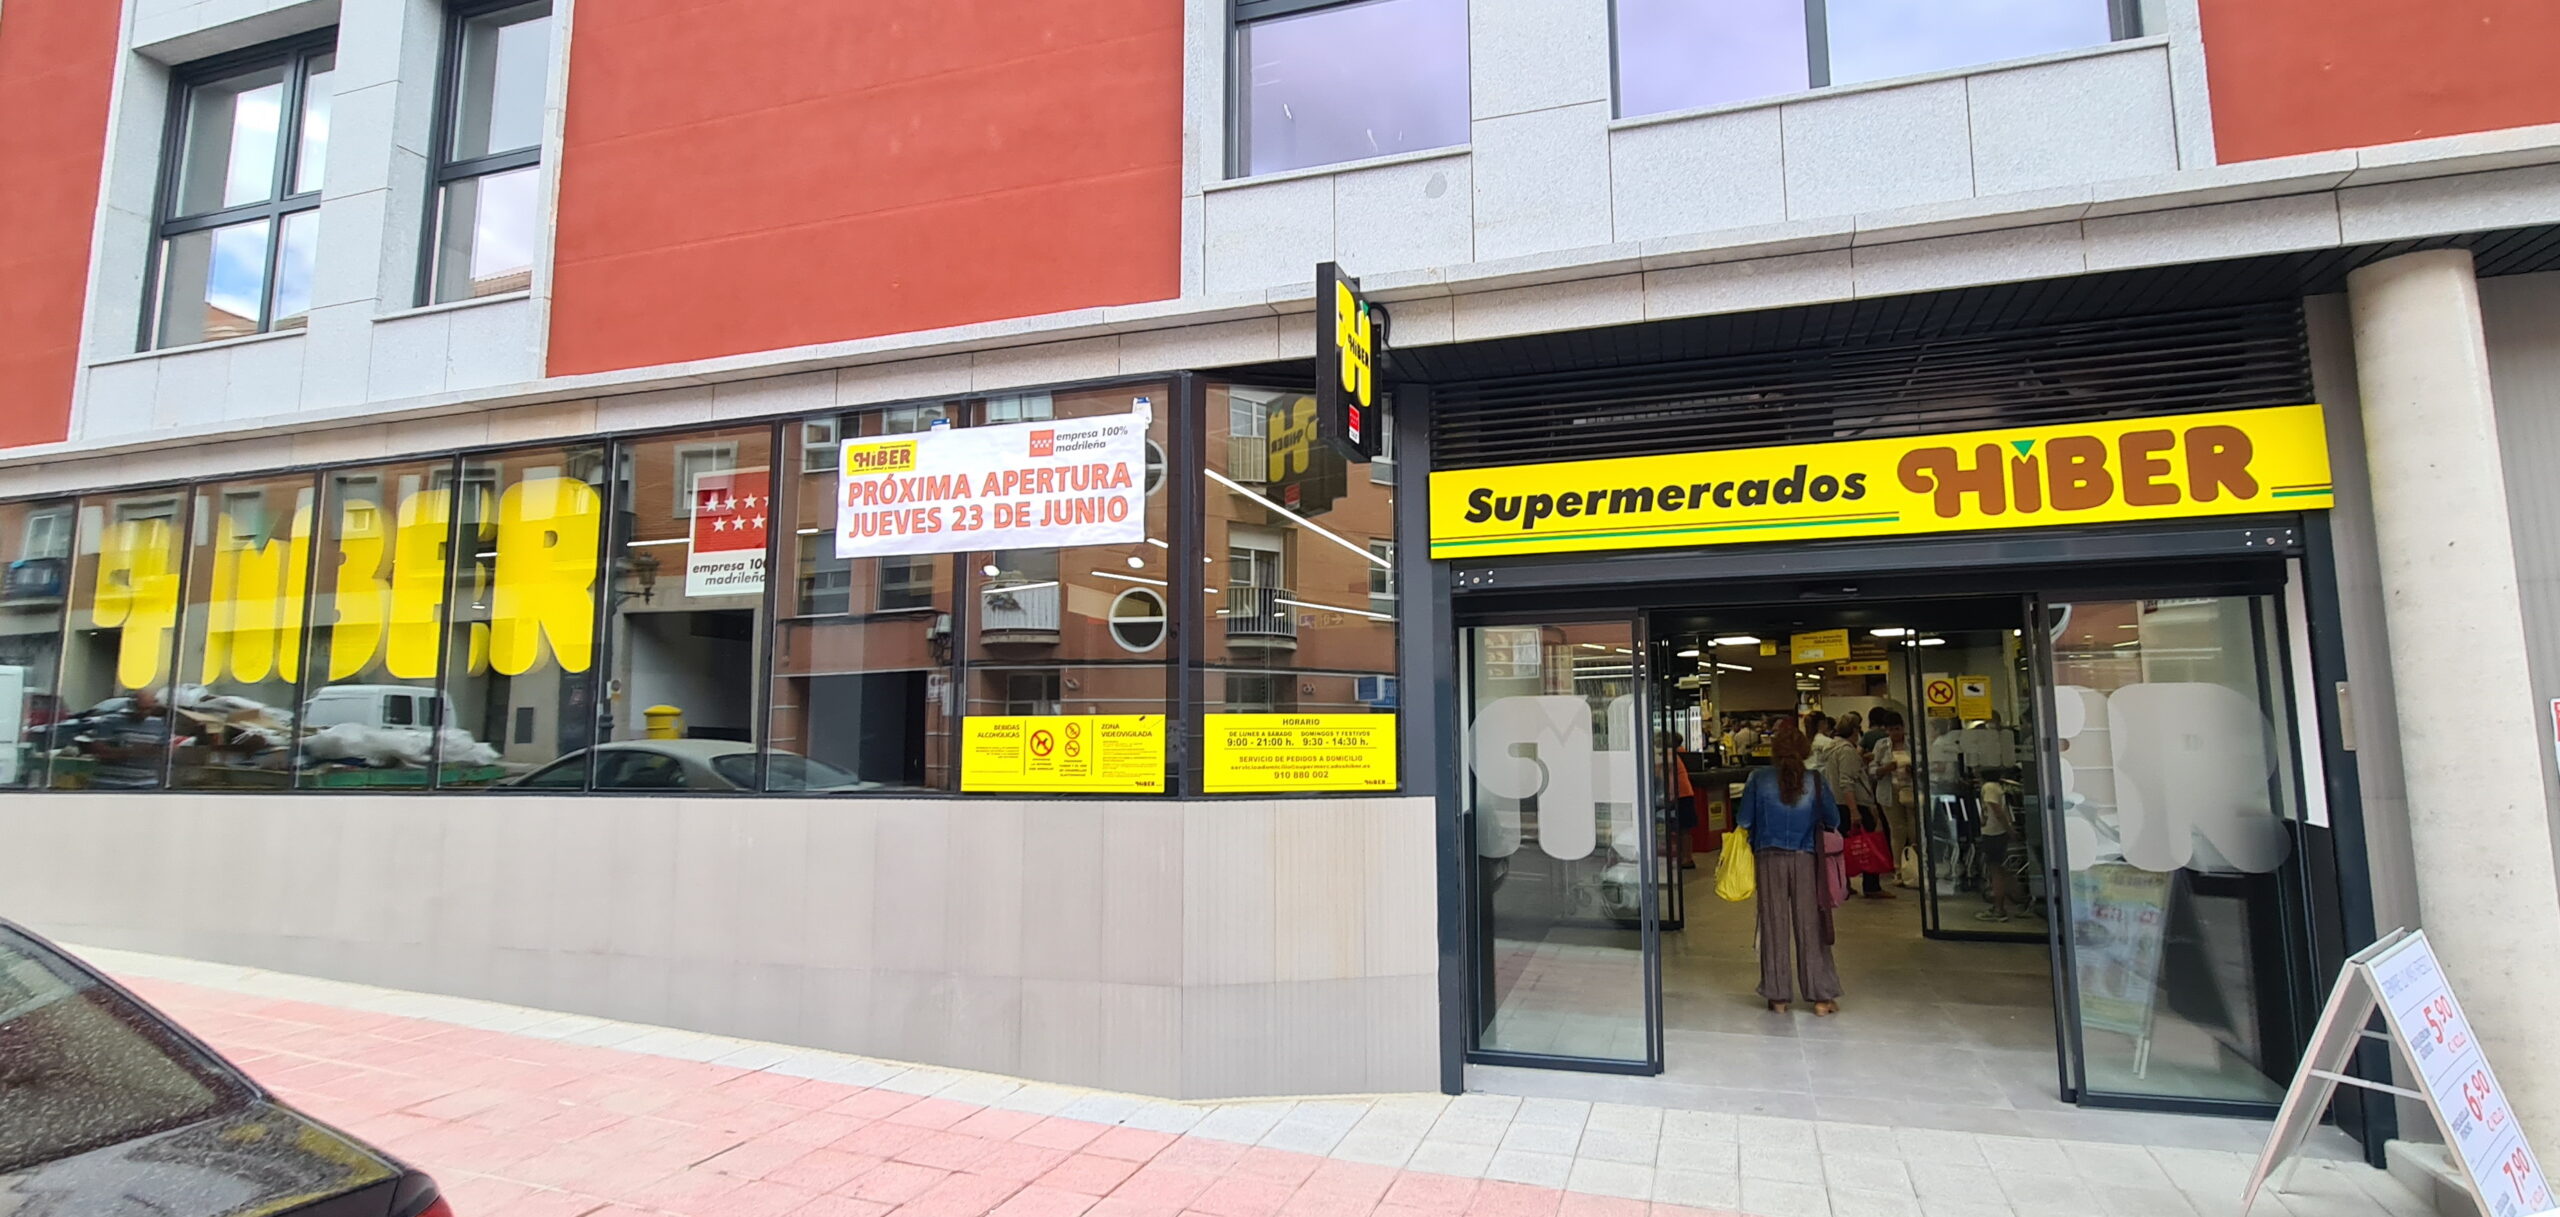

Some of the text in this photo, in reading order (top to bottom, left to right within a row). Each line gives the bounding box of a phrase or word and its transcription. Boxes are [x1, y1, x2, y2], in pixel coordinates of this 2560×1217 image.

[1055, 426, 1129, 442] empresa 100%
[1055, 440, 1106, 453] madrileña
[848, 462, 1132, 507] PRÓXIMA APERTURA
[1464, 464, 1867, 530] Supermercados
[849, 495, 1129, 539] JUEVES 23 DE JUNIO
[693, 562, 745, 575] empresa
[1282, 718, 1320, 726] HORARIO
[1227, 738, 1248, 746] 9:00
[1256, 738, 1283, 746] 21:00
[1285, 738, 1294, 746] h.
[1302, 738, 1324, 746] 9:30
[1332, 738, 1358, 746] 14:30
[1359, 737, 1369, 746] h.
[1239, 755, 1273, 763] SERVICIO
[1275, 755, 1285, 763] DE
[1286, 755, 1318, 763] PEDIDOS
[1274, 771, 1291, 779] 910
[1293, 771, 1310, 779] 880
